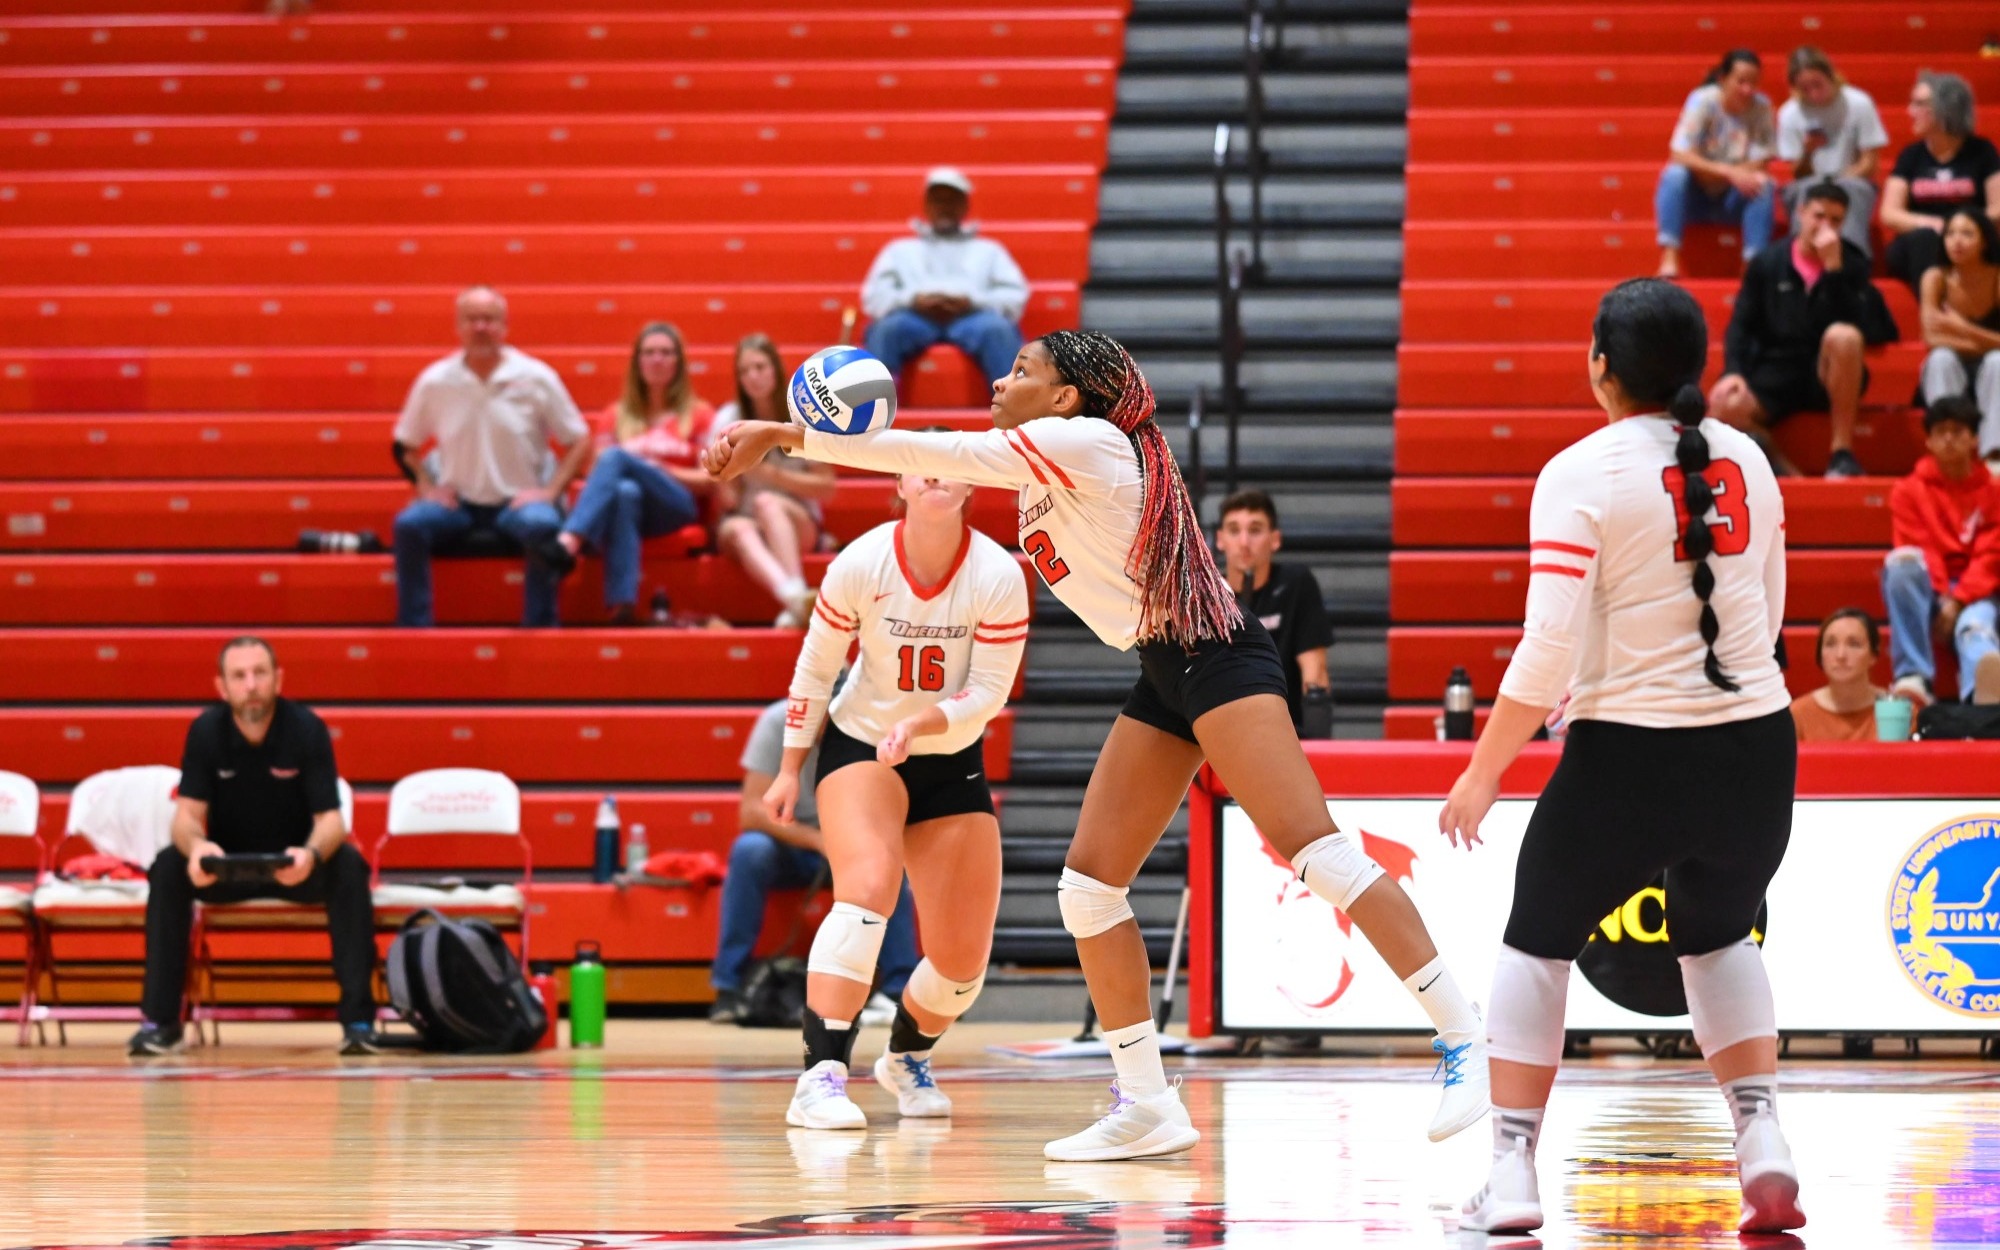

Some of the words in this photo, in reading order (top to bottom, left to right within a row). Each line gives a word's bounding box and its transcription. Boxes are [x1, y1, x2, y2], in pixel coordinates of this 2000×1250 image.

[806, 367, 841, 418] molten
[1662, 457, 1750, 562] 13
[1024, 529, 1071, 587] 2
[898, 645, 945, 692] 16
[1933, 911, 2000, 931] SUNY
